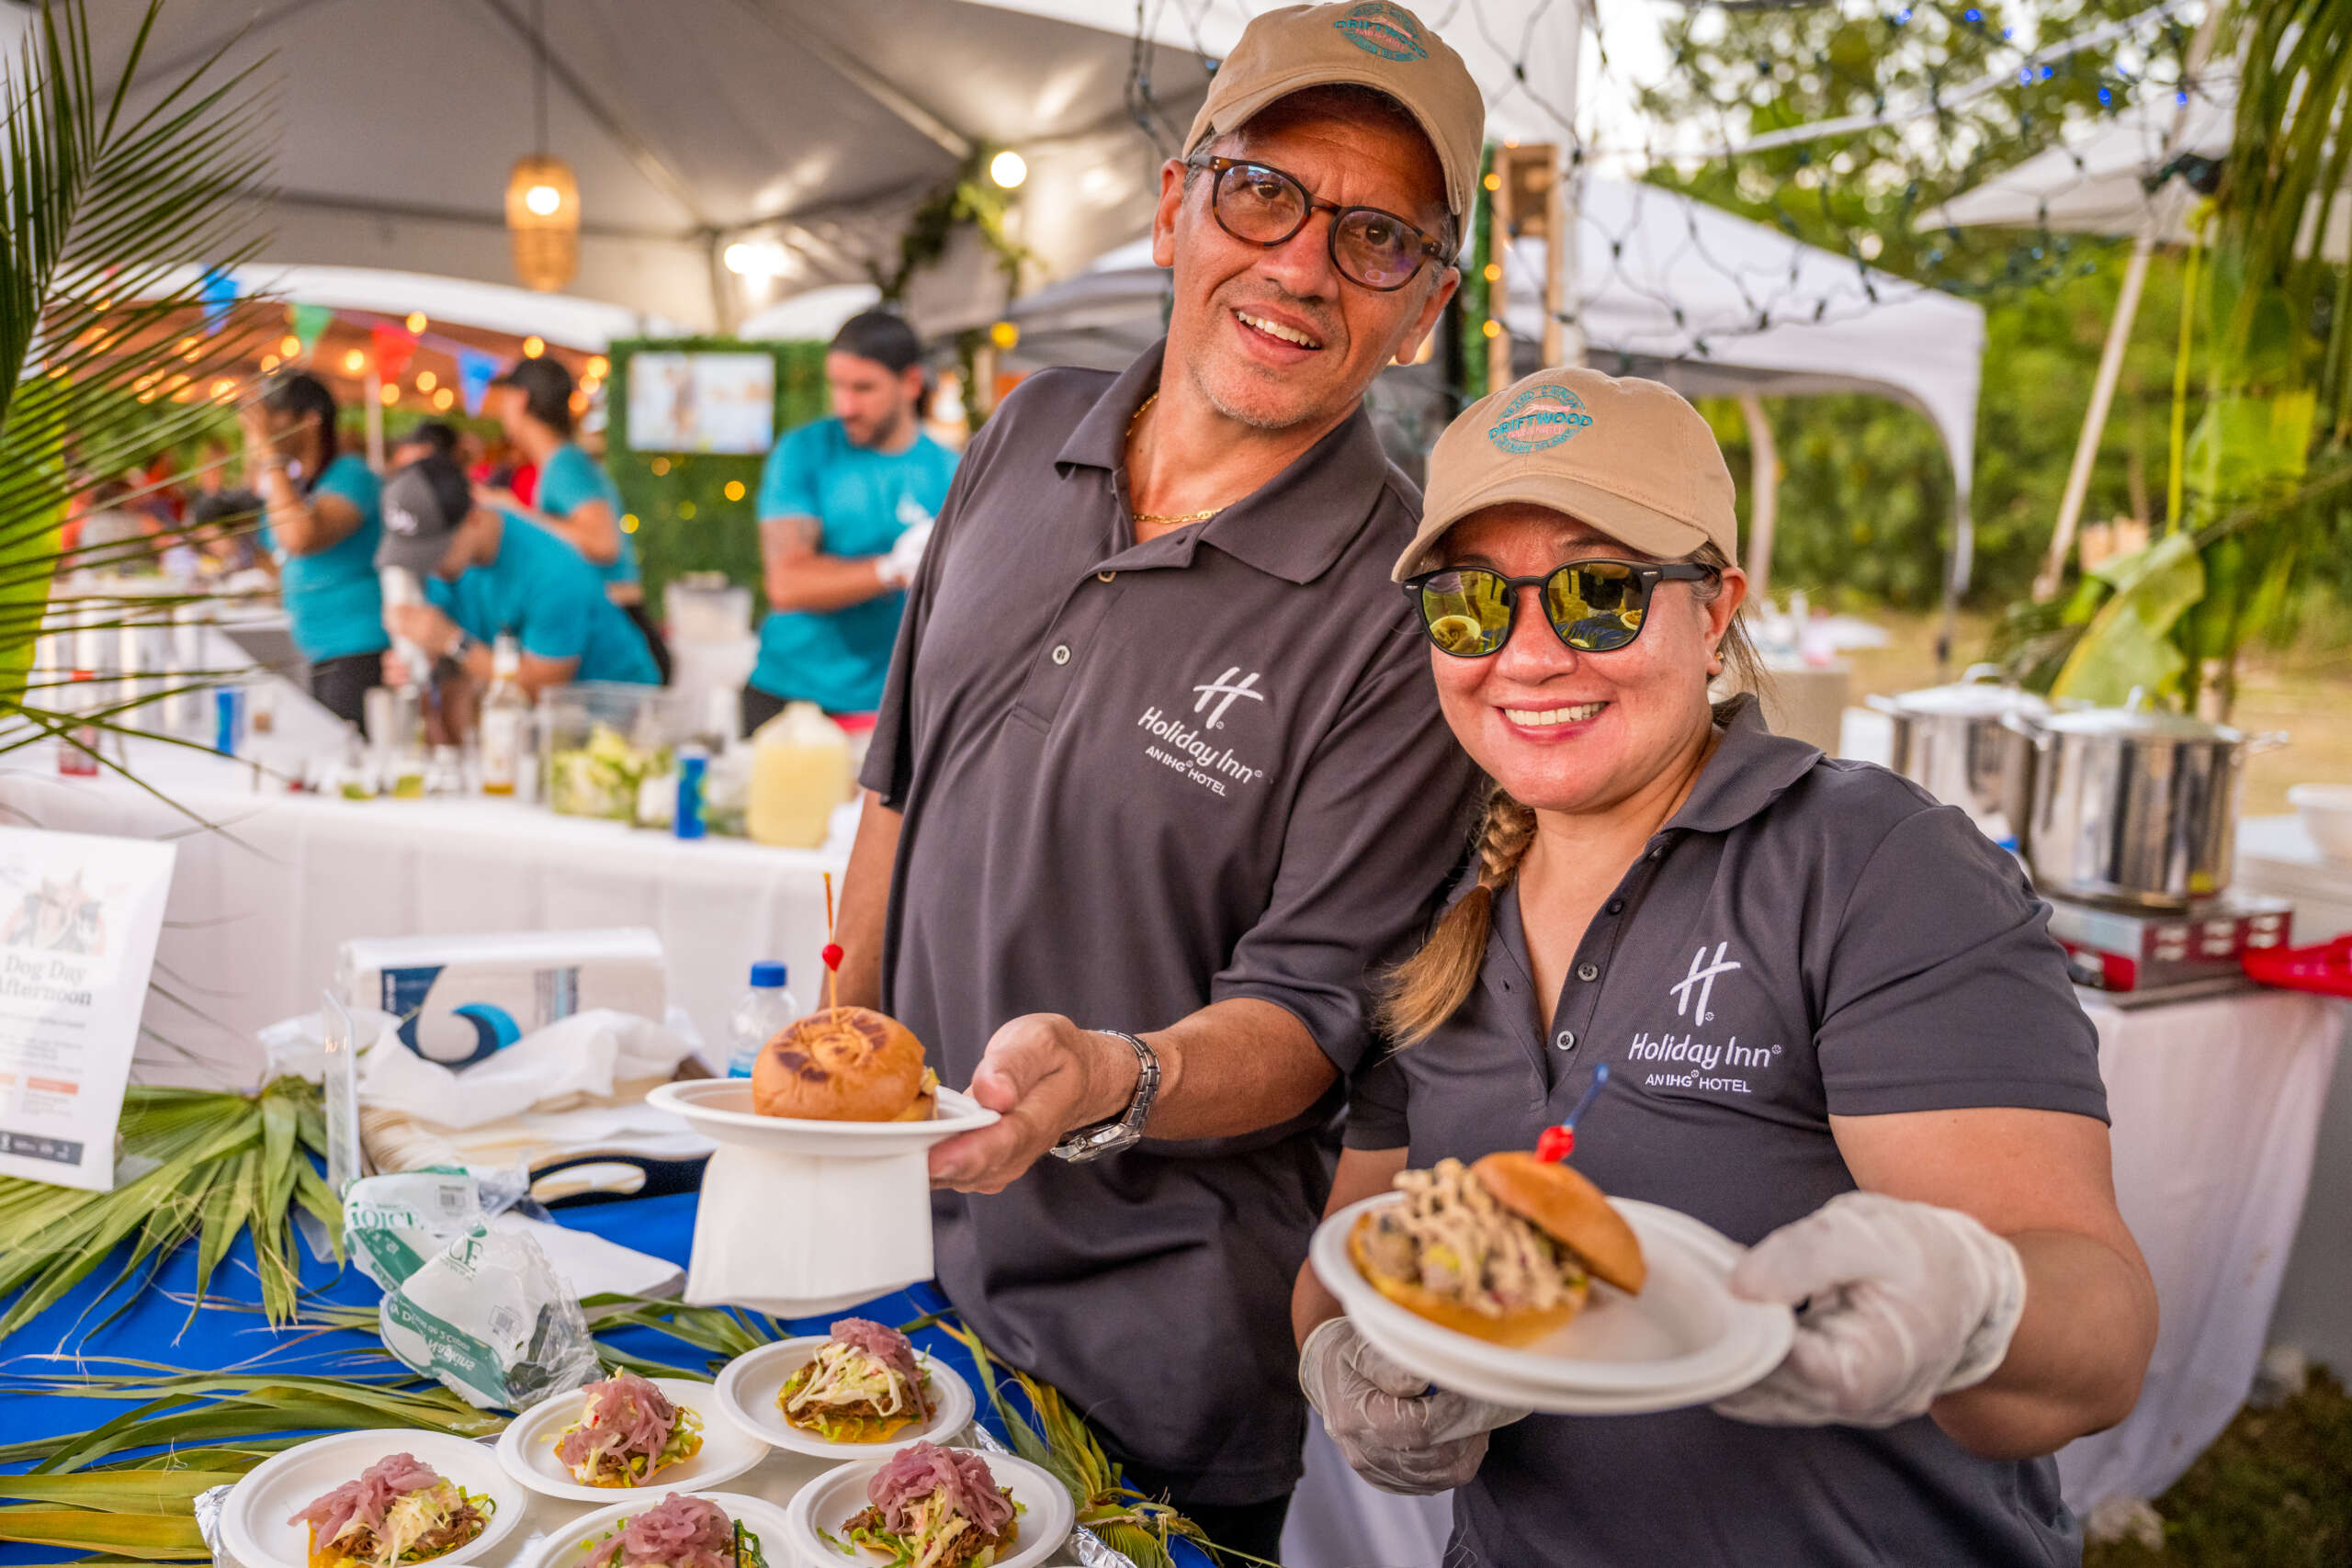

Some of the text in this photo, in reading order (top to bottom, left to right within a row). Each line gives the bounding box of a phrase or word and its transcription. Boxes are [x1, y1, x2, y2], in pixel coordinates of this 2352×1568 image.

[1334, 19, 1429, 60] DRIFTWOOD
[1487, 412, 1594, 441] DRIFTWOOD
[1137, 706, 1220, 766] Holiday
[1145, 745, 1164, 761] AN
[1187, 769, 1227, 797] HOTEL
[5, 953, 87, 986] Dog Day
[1628, 1032, 1723, 1070] Holiday
[1645, 1073, 1665, 1087] AN
[1699, 1077, 1752, 1092] HOTEL
